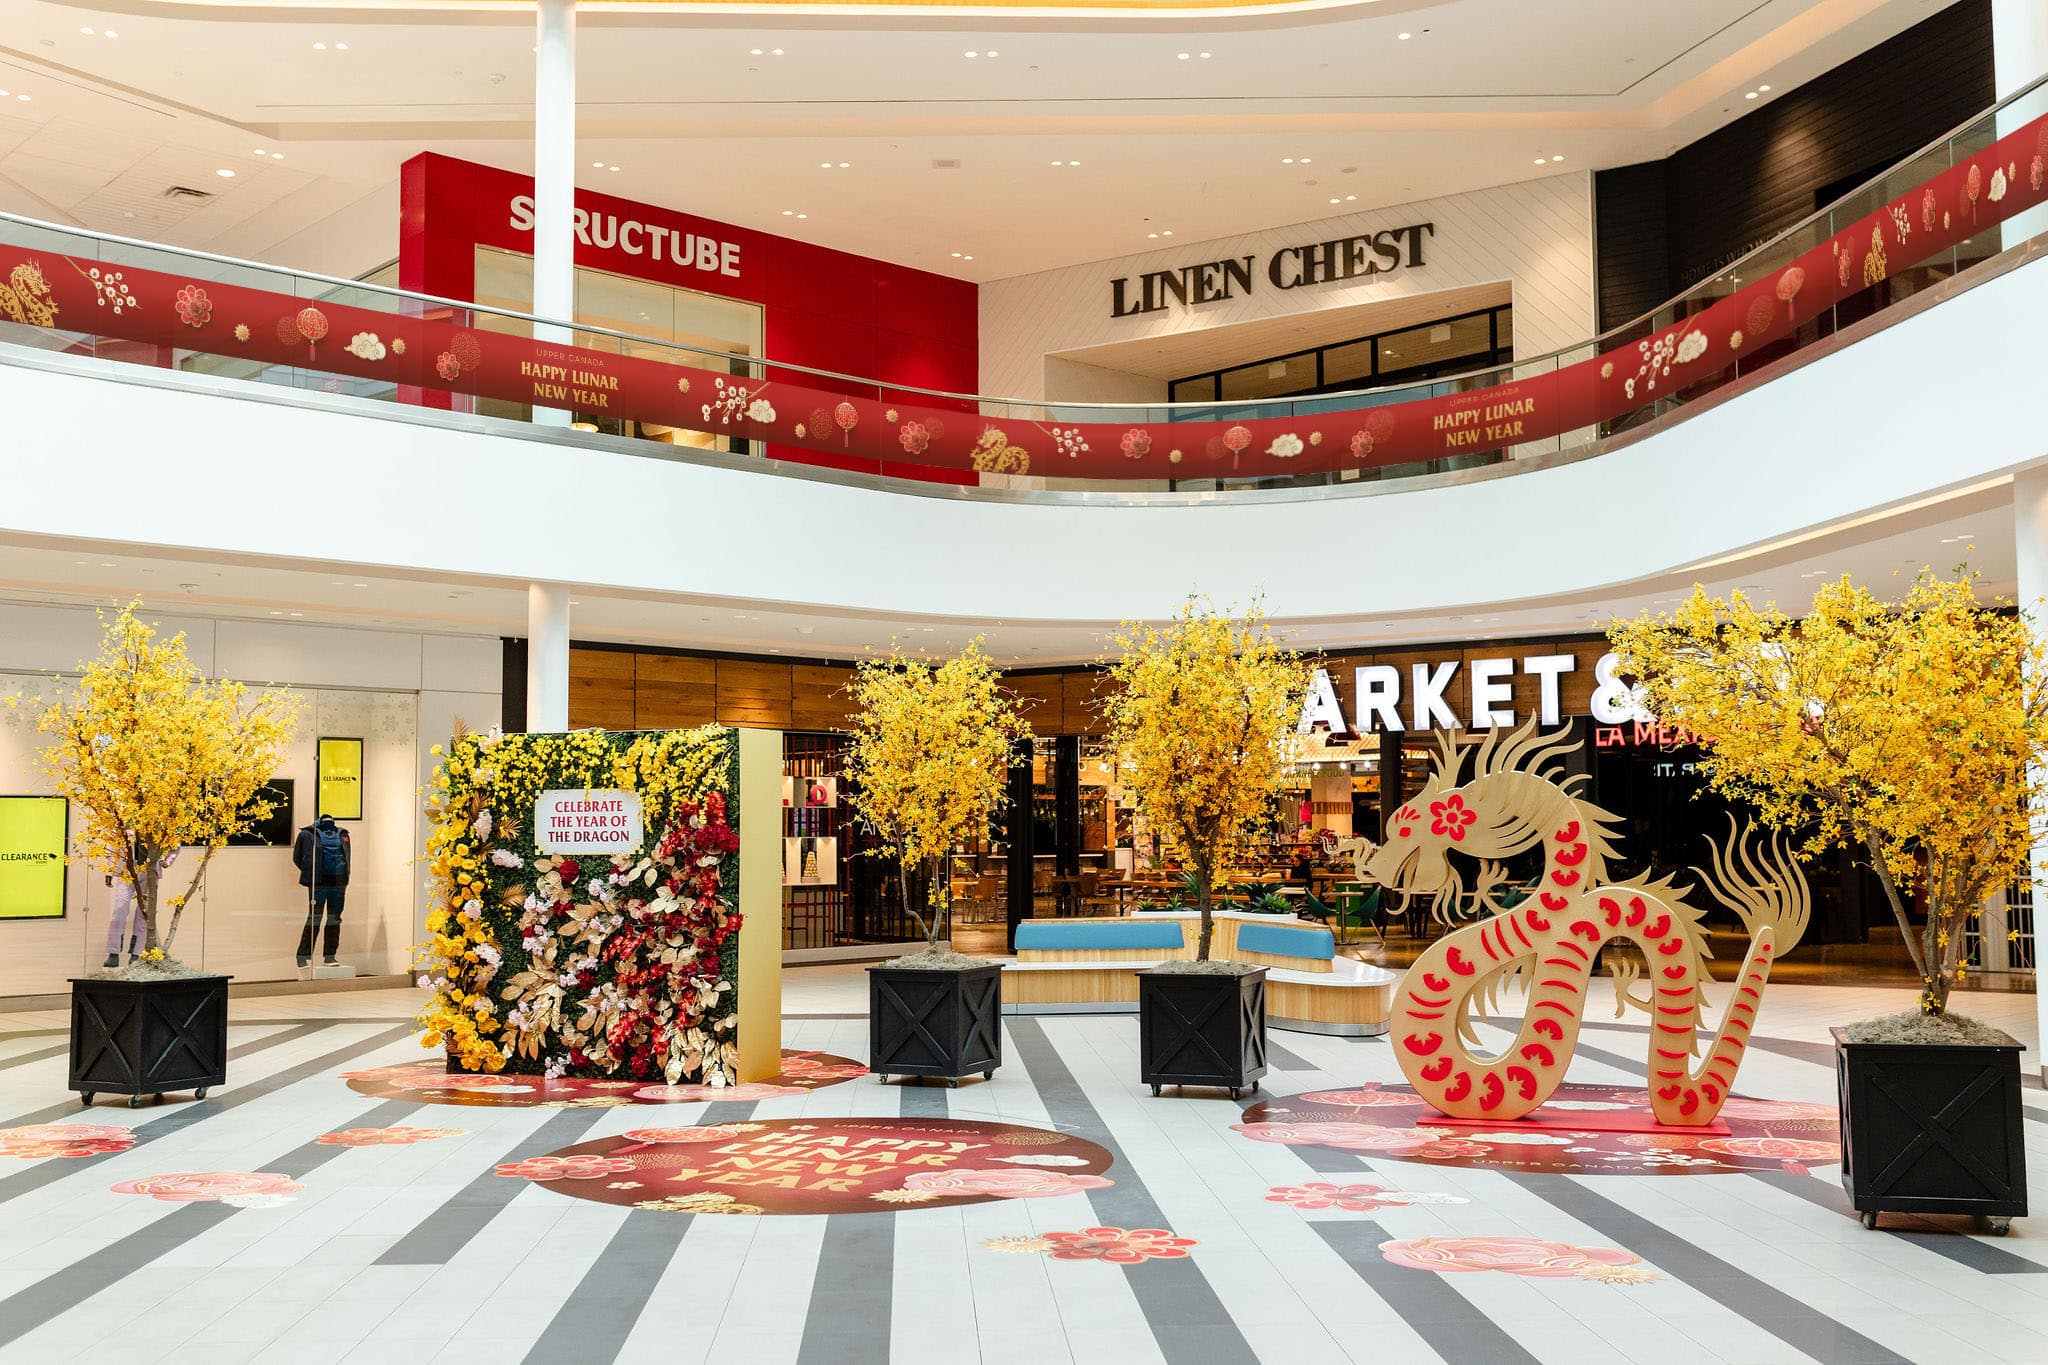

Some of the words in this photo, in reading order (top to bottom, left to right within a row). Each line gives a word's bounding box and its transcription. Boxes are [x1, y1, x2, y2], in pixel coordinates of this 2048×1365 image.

[510, 195, 741, 278] SRUCTUBE
[1110, 255, 1256, 318] LINEN
[1267, 222, 1435, 291] CHEST
[536, 348, 565, 360] UPPER
[568, 355, 604, 367] CANADA
[521, 361, 568, 382] HAPPY
[572, 370, 619, 391] LUNAR
[533, 382, 568, 401] NEW
[572, 388, 608, 408] YEAR
[1449, 395, 1479, 408] UPPER
[1481, 386, 1520, 401] CANADA
[1433, 408, 1481, 430] HAPPY
[1485, 397, 1535, 421] LUNAR
[1446, 428, 1481, 448] NEW
[1485, 420, 1524, 441] YEAR
[1292, 652, 1576, 733] ARKET
[554, 800, 624, 813] CELEBRATE
[550, 816, 573, 828] THE
[576, 815, 608, 828] YEAR
[611, 815, 628, 827] OF
[548, 831, 571, 843] THE
[573, 830, 630, 843] DRAGON
[1, 853, 48, 861] CLEARANCE
[750, 1132, 991, 1154] HAPPY
[706, 1156, 898, 1177] NEW
[708, 1143, 959, 1167] LUNAR
[1472, 1158, 1542, 1167] UPPER
[1551, 1161, 1646, 1171] CANADA
[666, 1168, 864, 1193] YEAR
